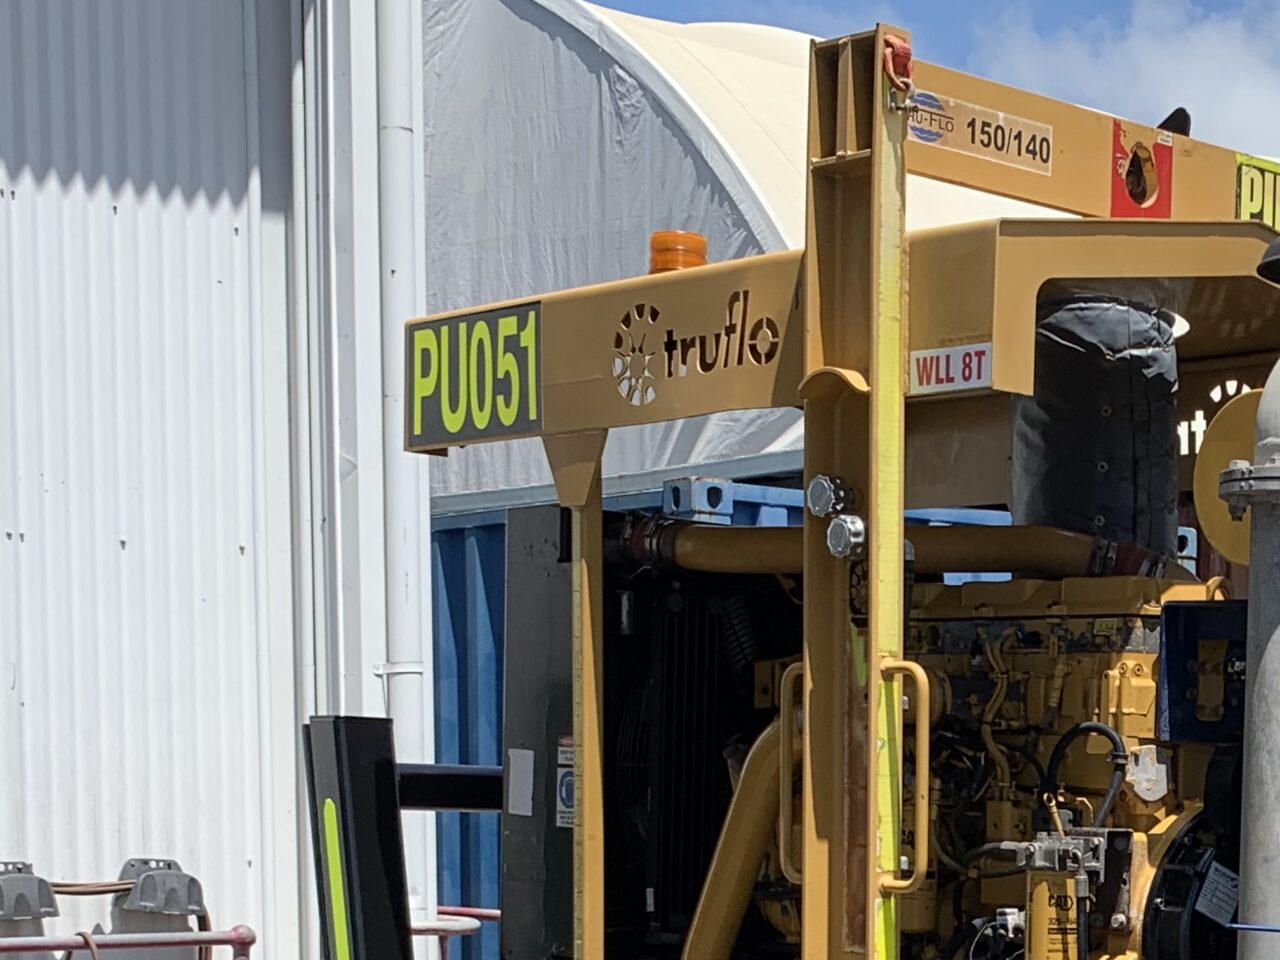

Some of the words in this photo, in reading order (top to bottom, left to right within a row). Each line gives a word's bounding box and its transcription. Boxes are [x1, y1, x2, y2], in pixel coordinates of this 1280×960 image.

[906, 109, 955, 133] RU-FLO
[966, 117, 1051, 164] 150/140
[663, 289, 780, 378] truflo
[916, 353, 955, 386] WLL
[962, 350, 987, 382] 8T
[413, 310, 538, 436] PU051
